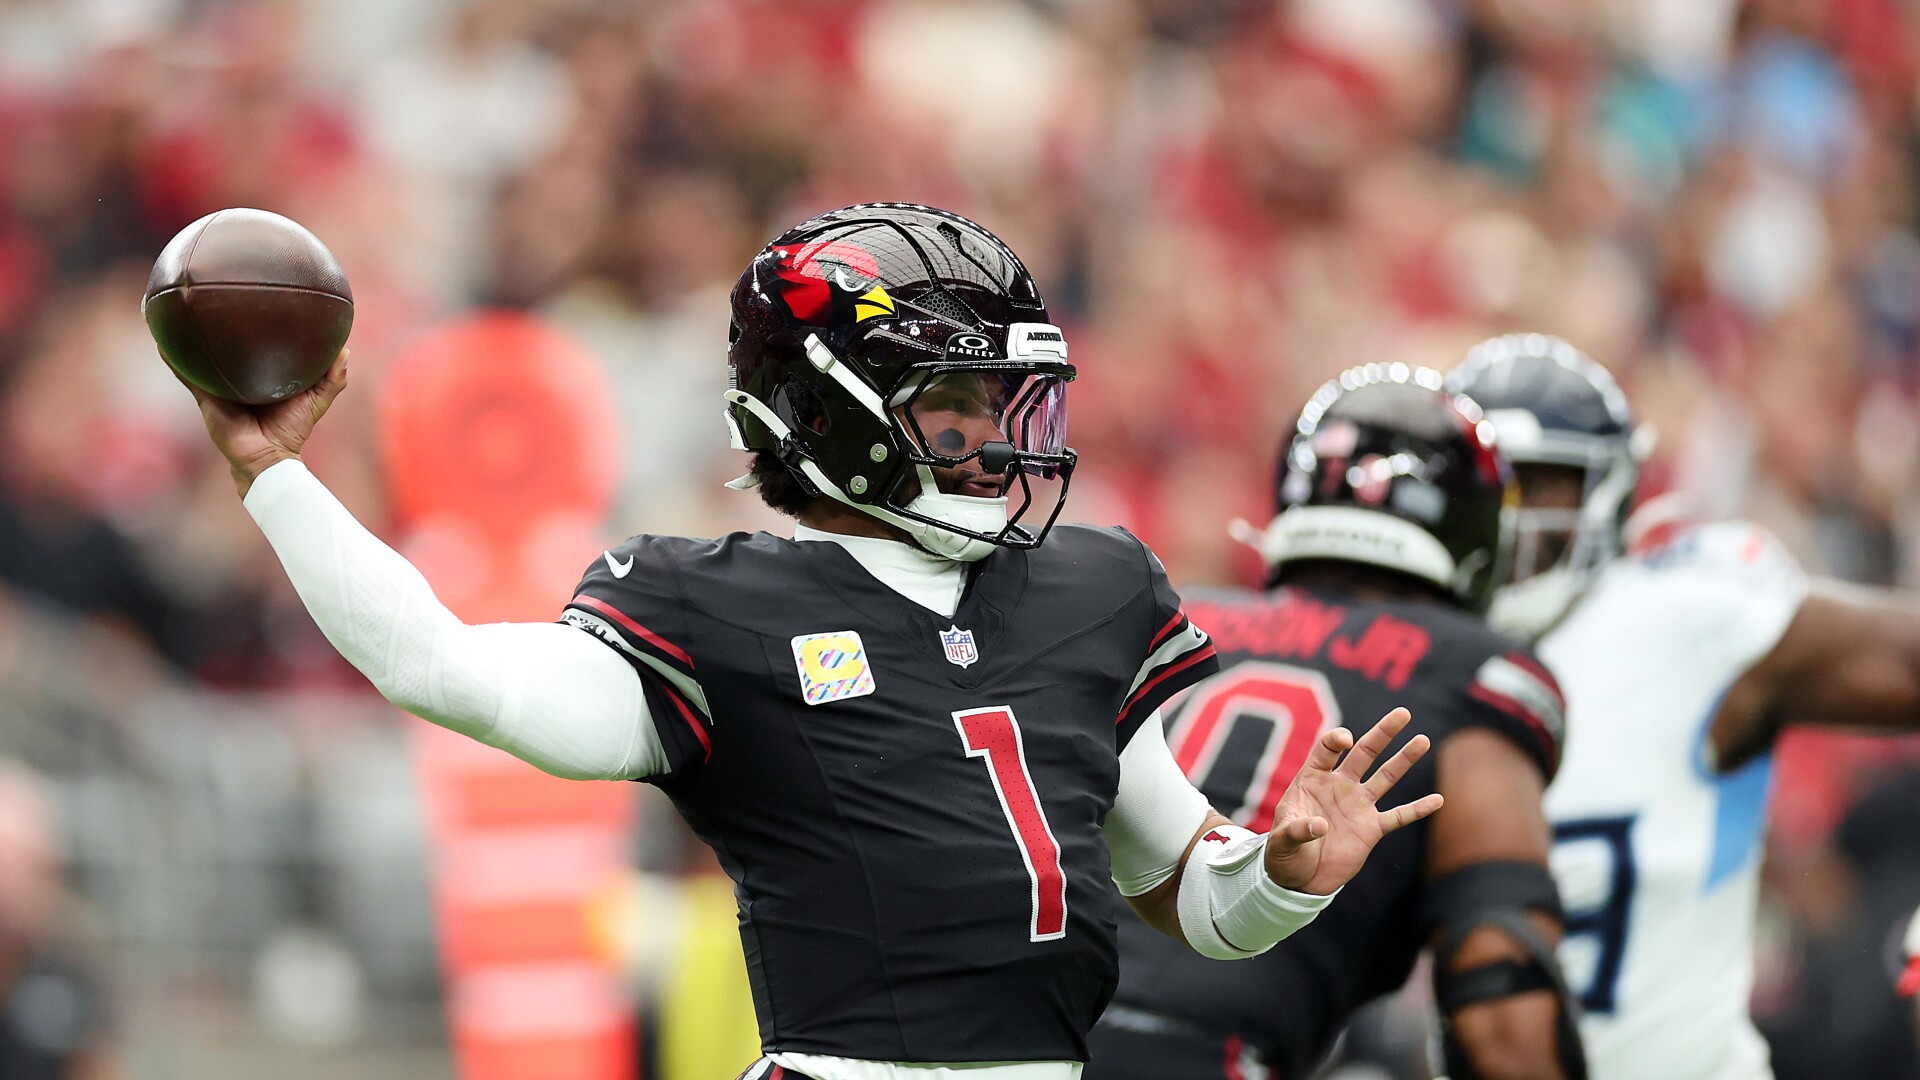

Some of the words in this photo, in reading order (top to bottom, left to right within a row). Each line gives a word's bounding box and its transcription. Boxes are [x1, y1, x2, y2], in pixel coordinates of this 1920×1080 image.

[949, 346, 996, 358] OAKLEY
[802, 637, 864, 684] C
[949, 644, 973, 660] NFL
[1328, 613, 1432, 690] JR
[1163, 659, 1343, 833] 0
[951, 704, 1068, 943] 1
